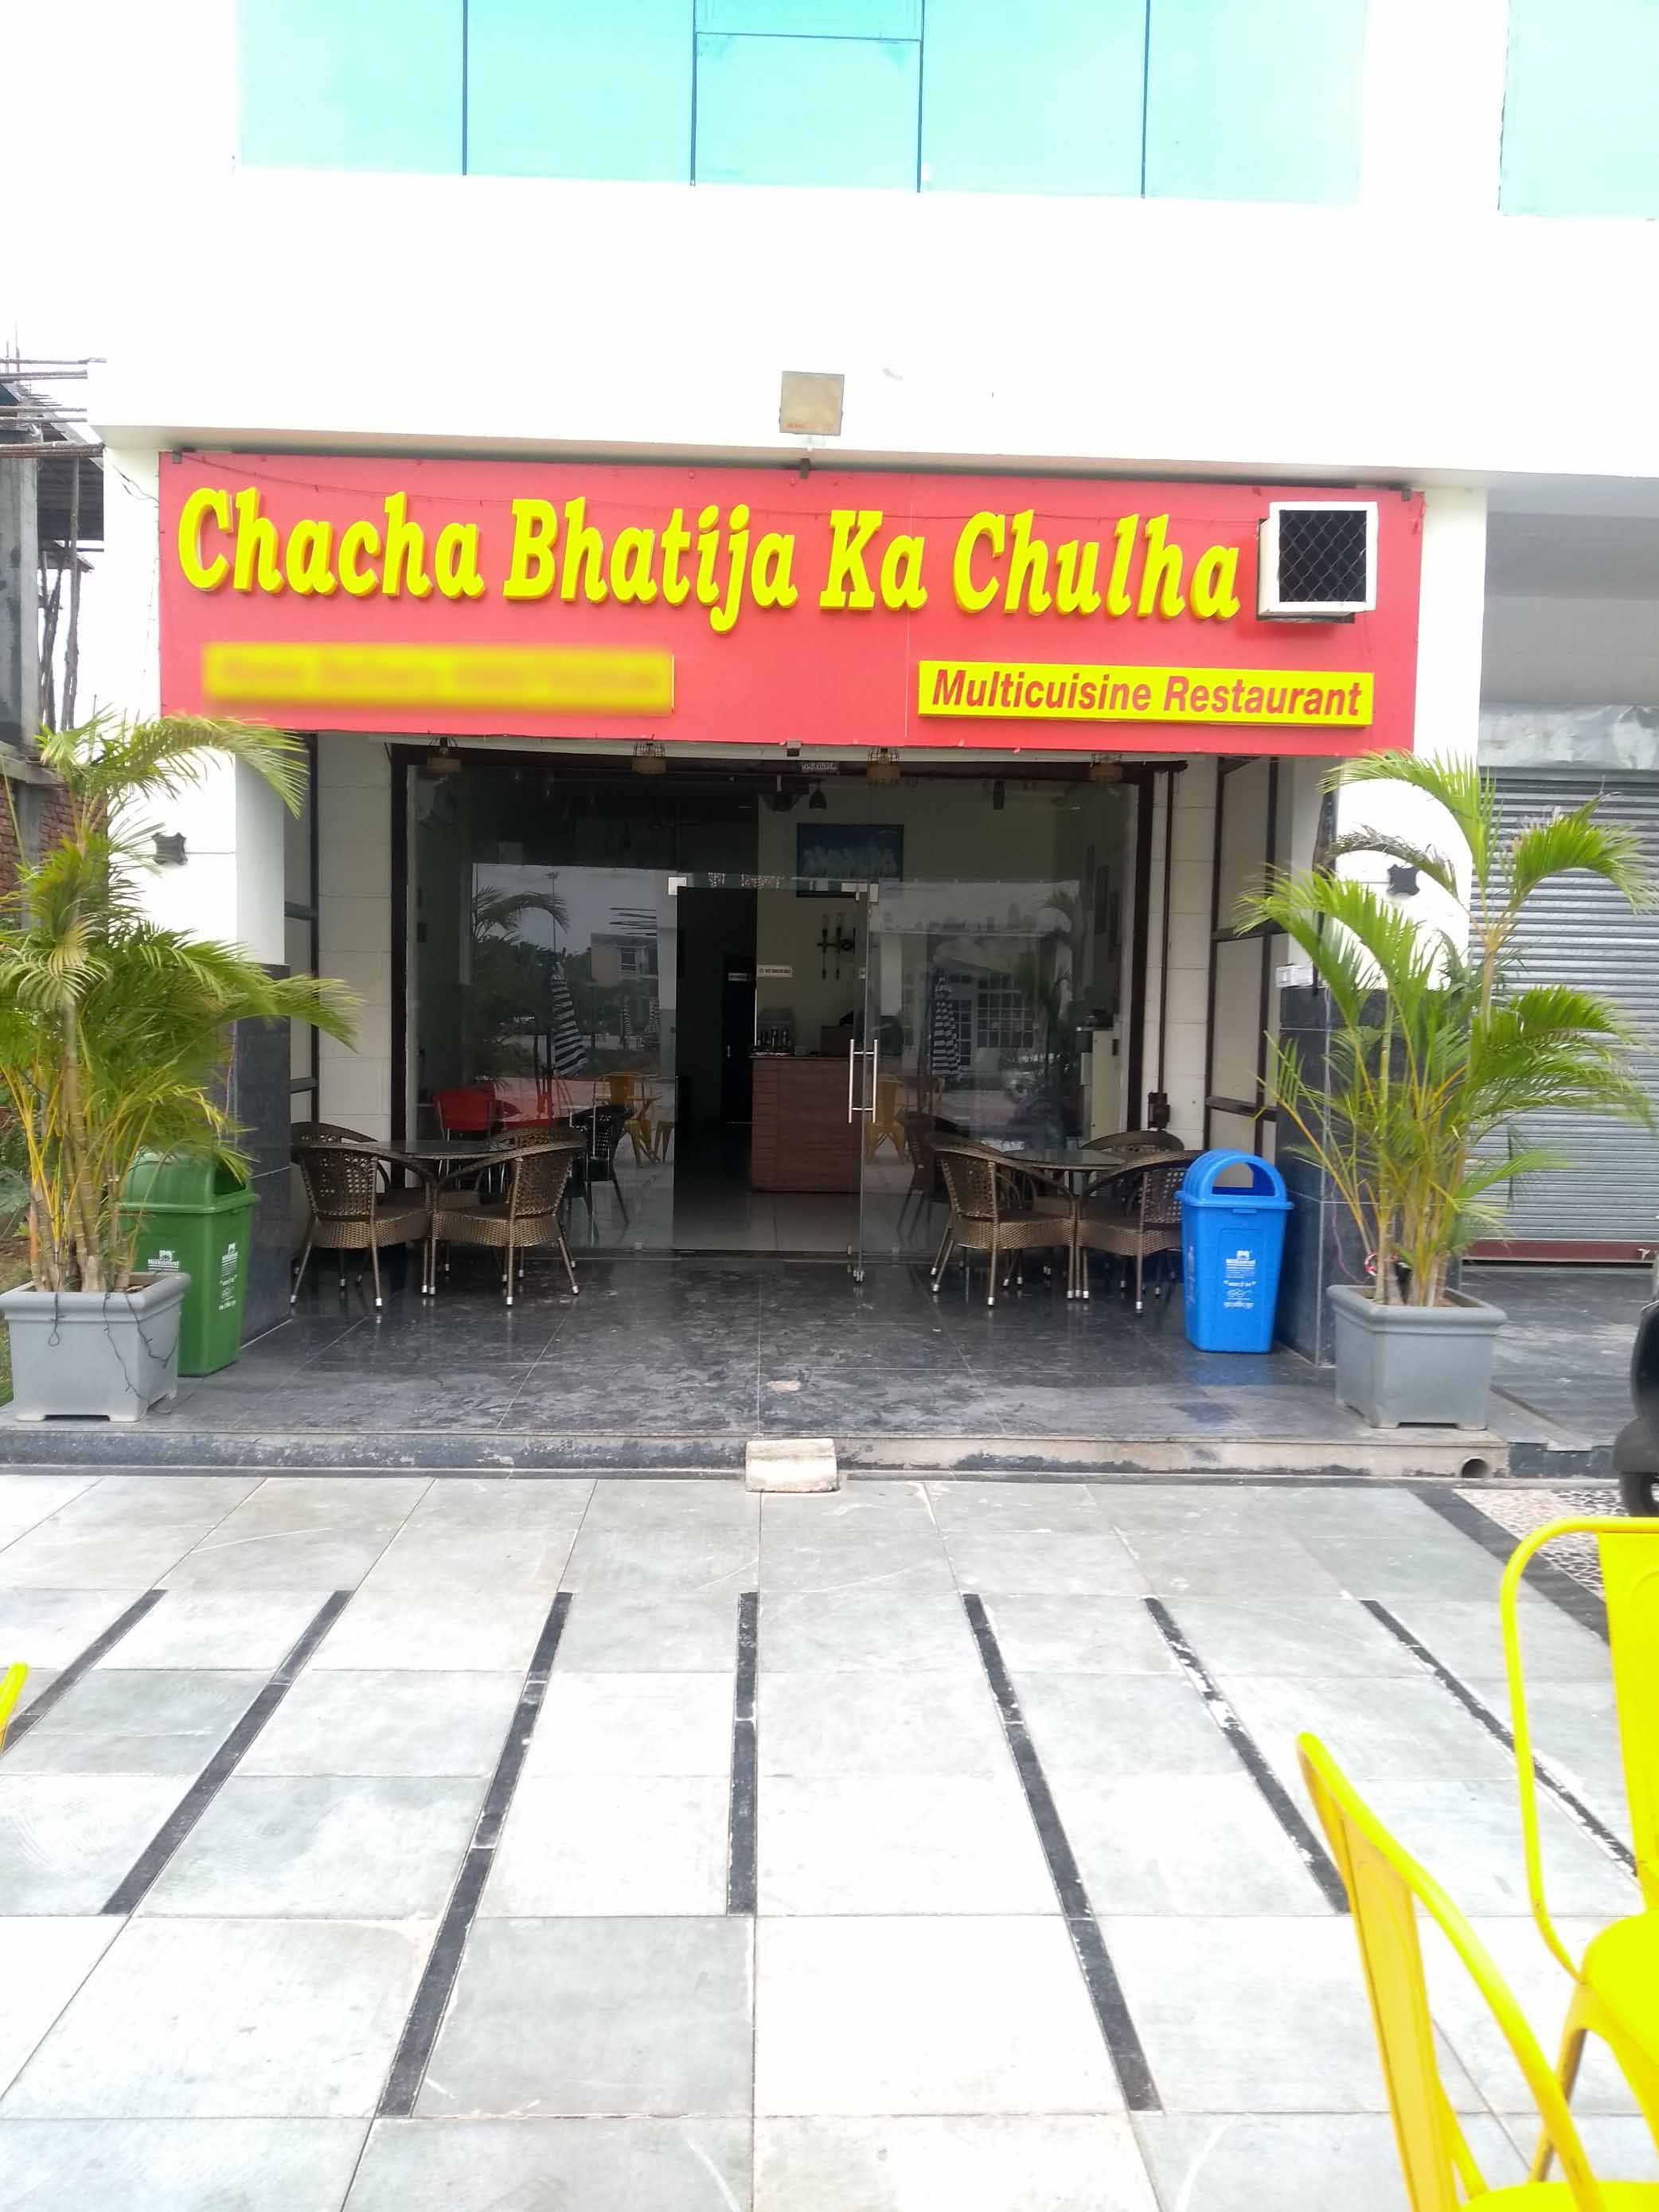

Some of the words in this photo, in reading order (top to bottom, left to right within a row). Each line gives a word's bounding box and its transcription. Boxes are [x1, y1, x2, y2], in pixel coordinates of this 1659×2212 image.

[176, 486, 486, 599] Chacha
[501, 497, 798, 634] Bhatija
[818, 509, 928, 611] Ka
[951, 509, 1240, 619] Chulha
[932, 669, 1152, 712] Multicuisine
[1163, 676, 1361, 717] Restaurant
